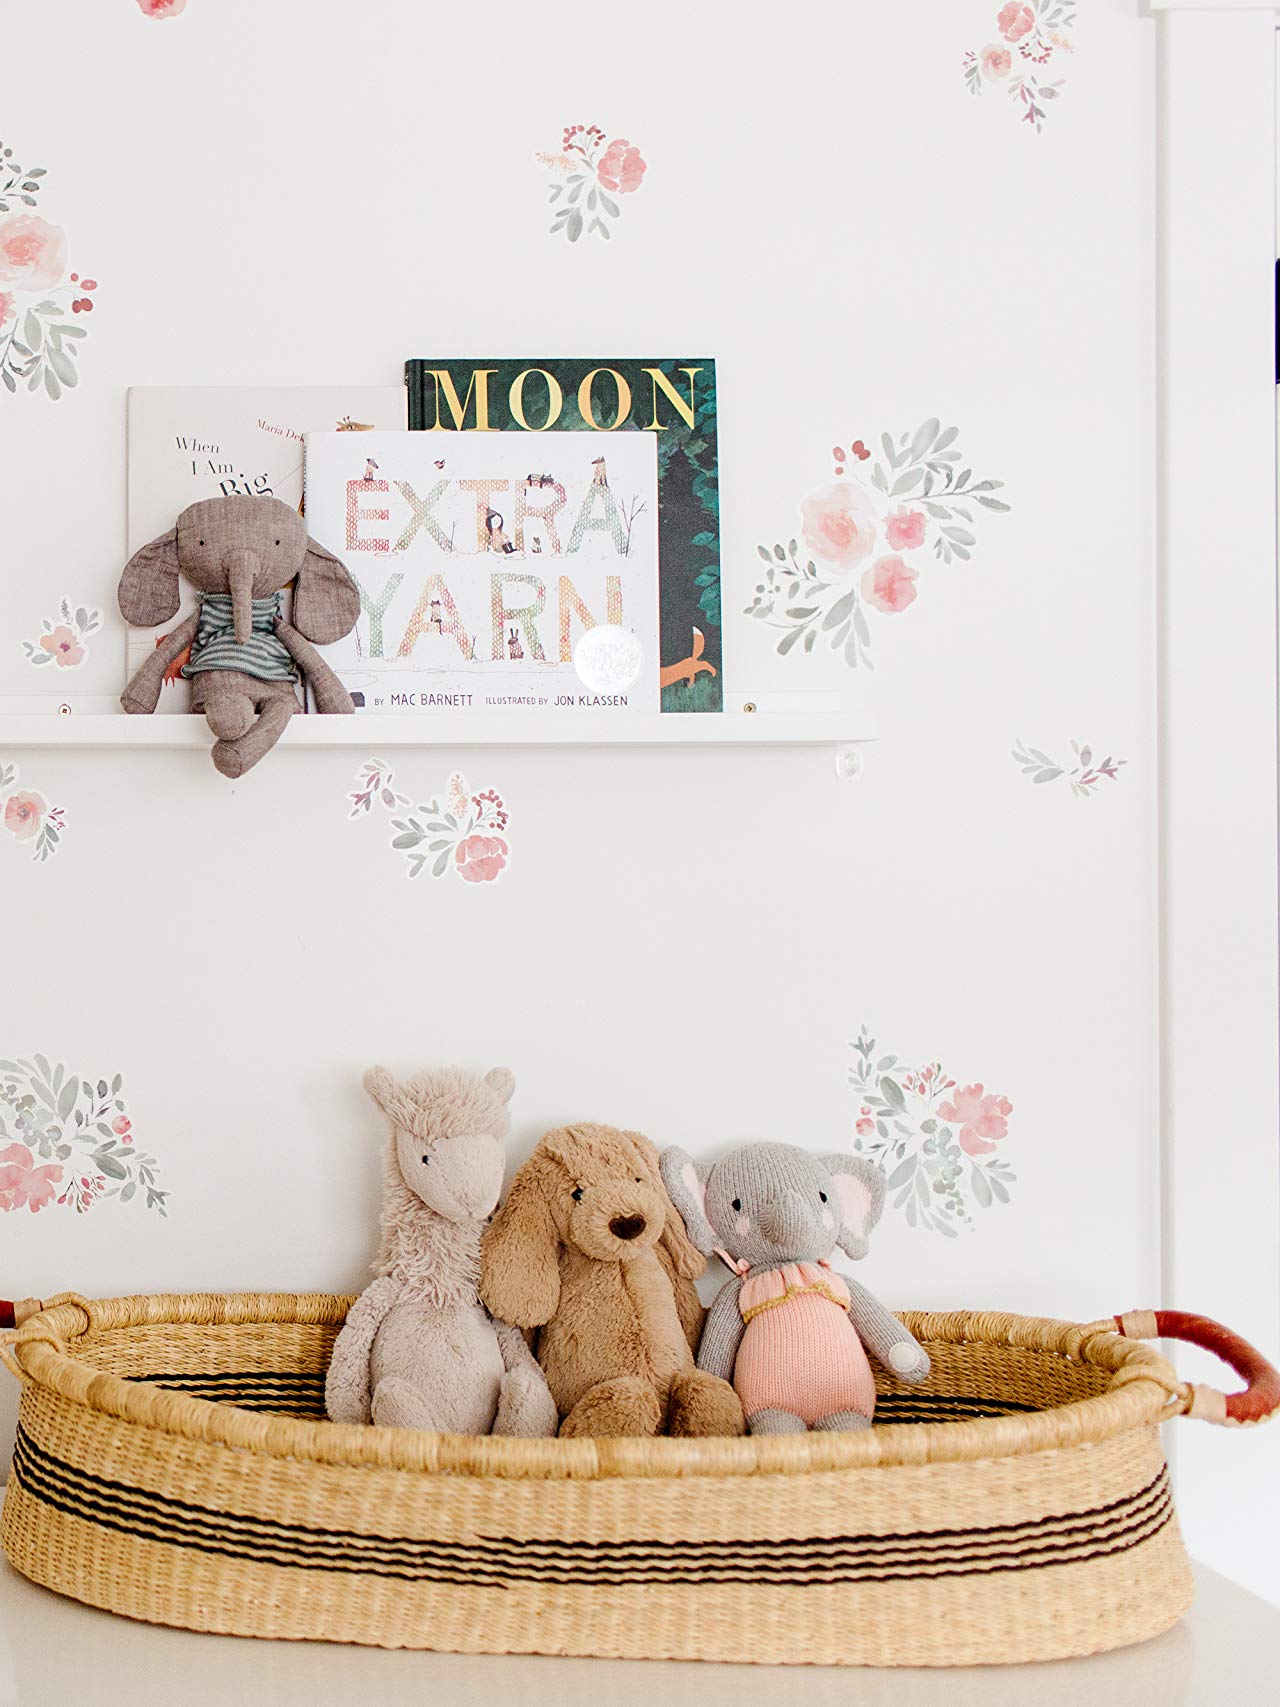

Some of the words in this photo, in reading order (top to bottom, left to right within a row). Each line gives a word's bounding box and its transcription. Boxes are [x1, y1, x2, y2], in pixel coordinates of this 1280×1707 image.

[424, 367, 704, 431] MOON
[255, 418, 283, 437] Maria
[175, 436, 220, 454] When
[192, 460, 196, 475] I
[204, 459, 234, 475] Am
[216, 473, 274, 497] Big
[345, 479, 630, 554] EXTRA
[349, 573, 623, 662] YARN
[374, 697, 385, 706] BY
[391, 693, 416, 706] MAC
[421, 693, 473, 707] BARNETT
[485, 696, 536, 705] ILLUSTRATED
[538, 697, 549, 705] BY
[554, 695, 575, 706] JON
[579, 695, 629, 706] KLASSEN
